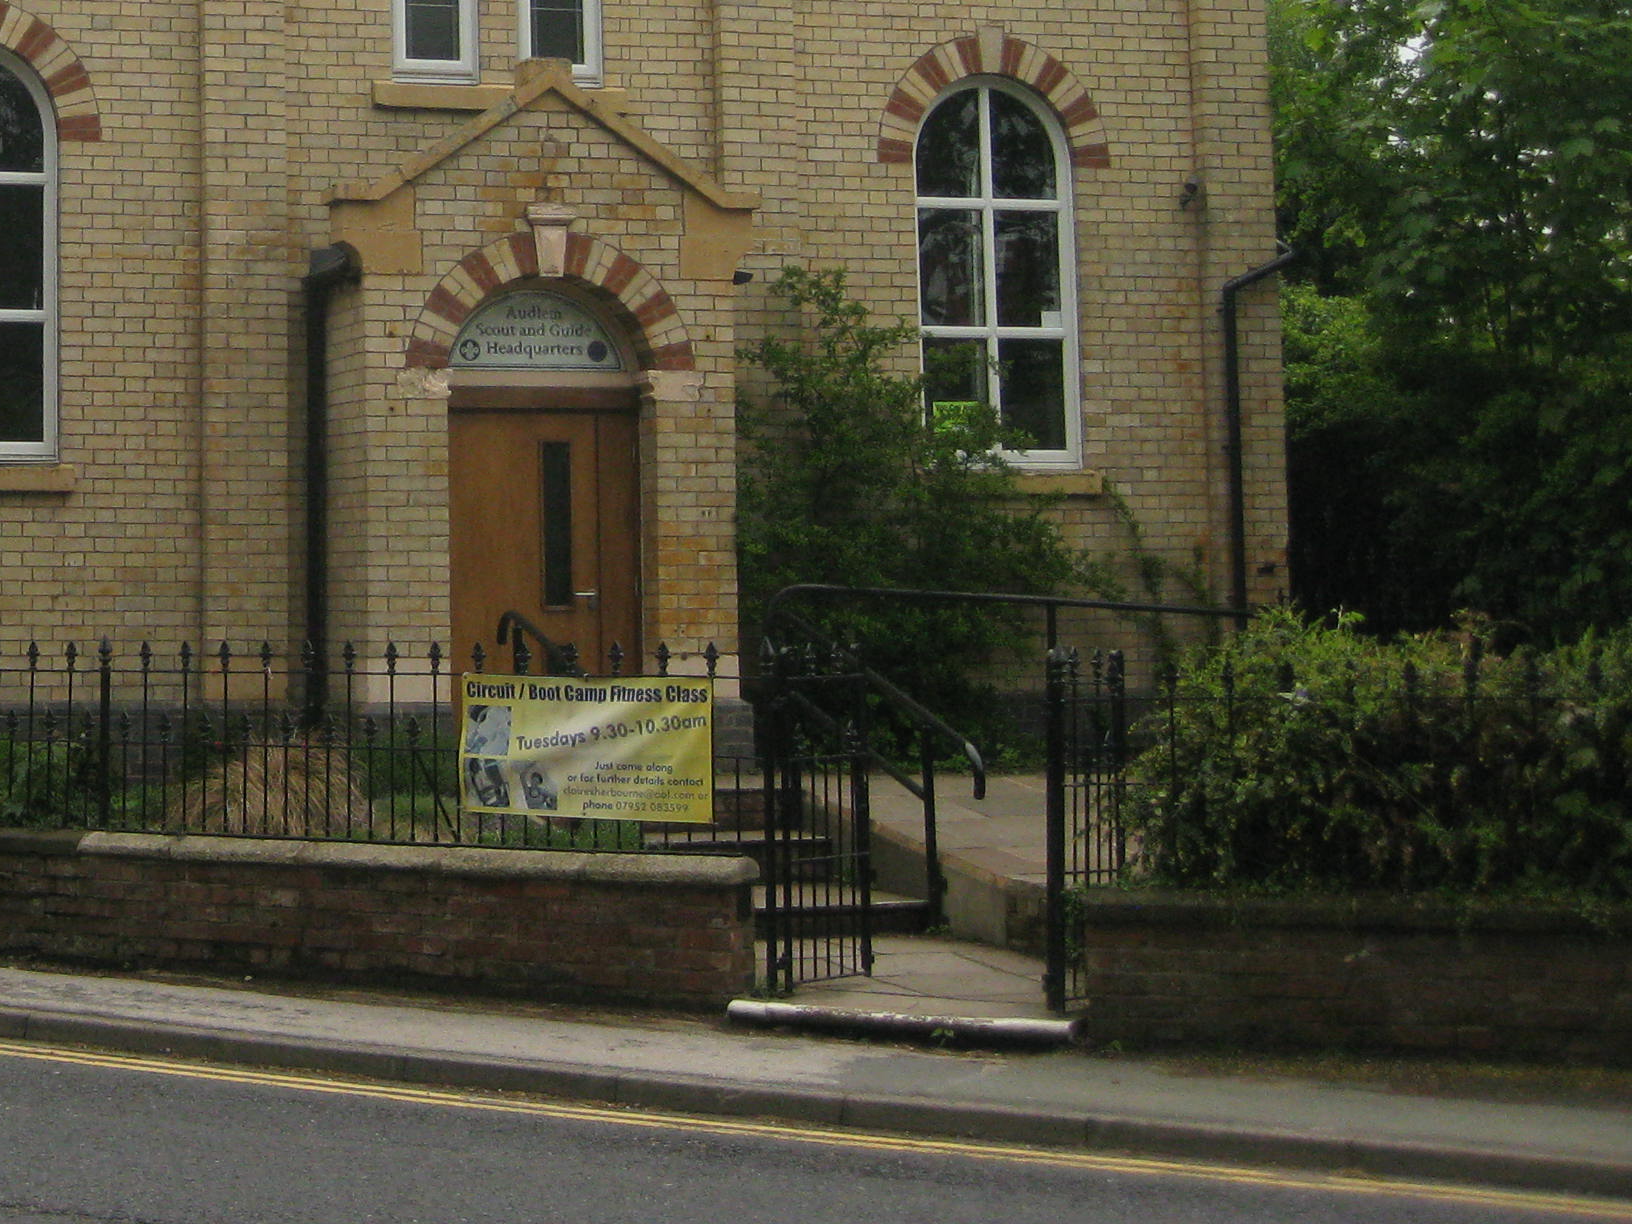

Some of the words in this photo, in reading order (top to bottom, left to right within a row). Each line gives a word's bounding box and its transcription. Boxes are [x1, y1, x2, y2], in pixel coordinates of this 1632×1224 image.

[506, 306, 562, 320] Audlem
[477, 324, 515, 337] Scout
[520, 324, 545, 337] and
[549, 324, 592, 338] Guide
[487, 342, 583, 359] Headquarters
[467, 681, 515, 699] Circuit
[519, 683, 525, 700] /
[529, 684, 561, 701] Boot
[565, 685, 607, 703] Camp
[610, 686, 663, 702] Fitness
[666, 686, 708, 702] Class
[517, 730, 586, 751] Tuesdays
[590, 716, 707, 741] 9.30-10.30am
[595, 761, 613, 770] Just
[616, 763, 642, 771] come
[646, 762, 673, 774] along
[580, 773, 593, 782] for
[597, 774, 630, 784] further
[634, 775, 665, 785] details
[667, 778, 704, 787] contact
[698, 792, 708, 800] or
[582, 799, 613, 810] phone
